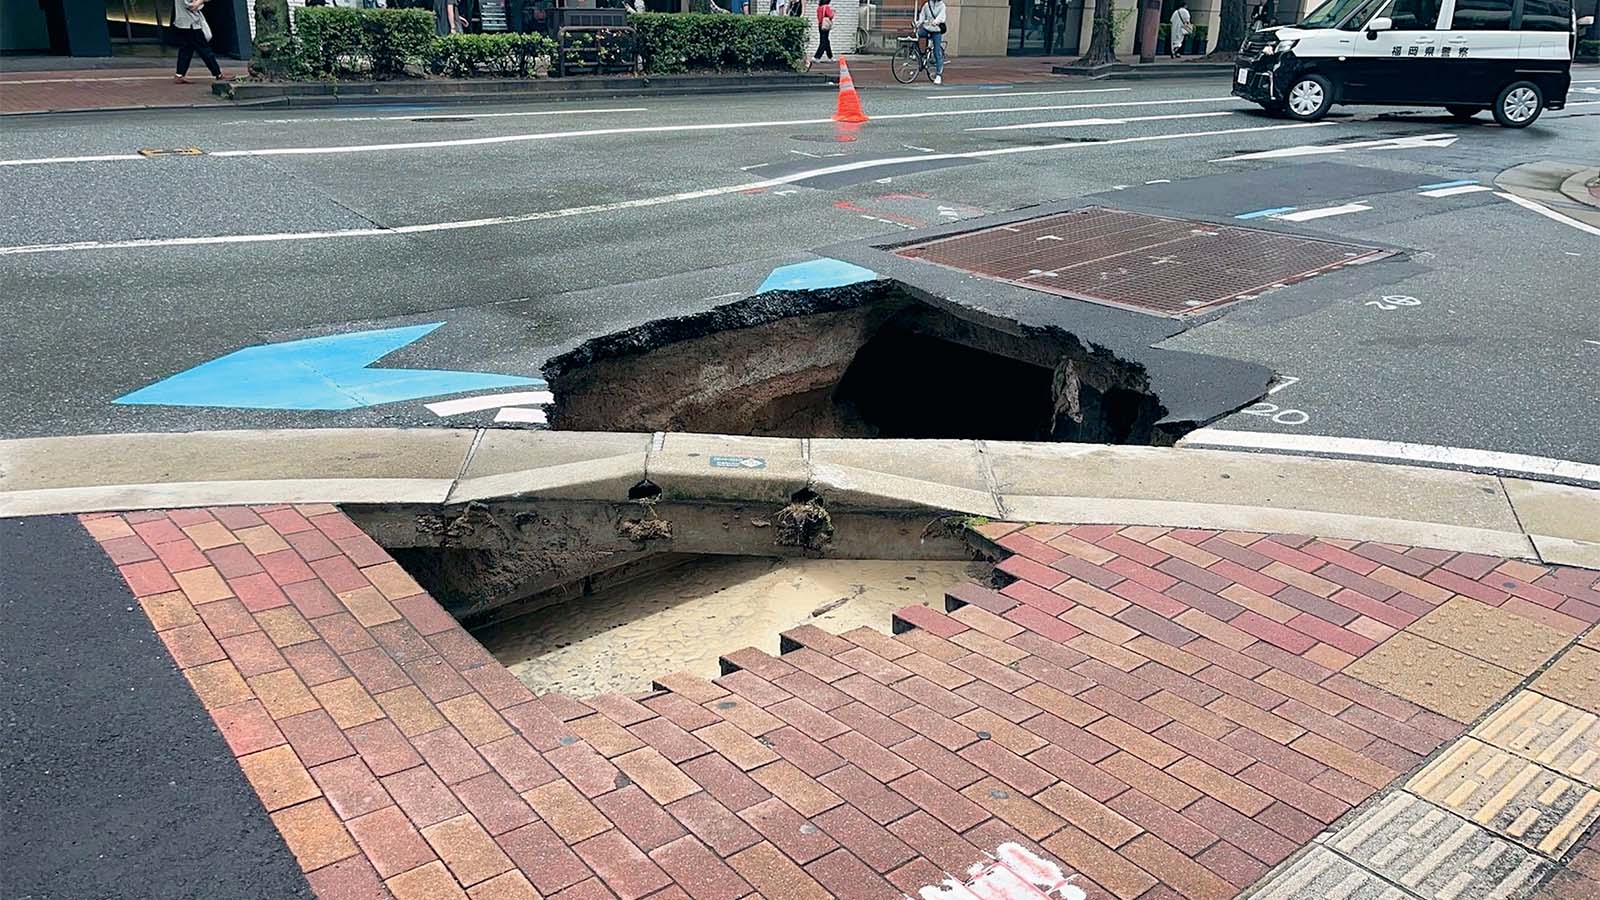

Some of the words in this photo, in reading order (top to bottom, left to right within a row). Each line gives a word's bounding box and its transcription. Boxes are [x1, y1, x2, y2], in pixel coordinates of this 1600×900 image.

[1391, 46, 1469, 57] 福岡県警察
